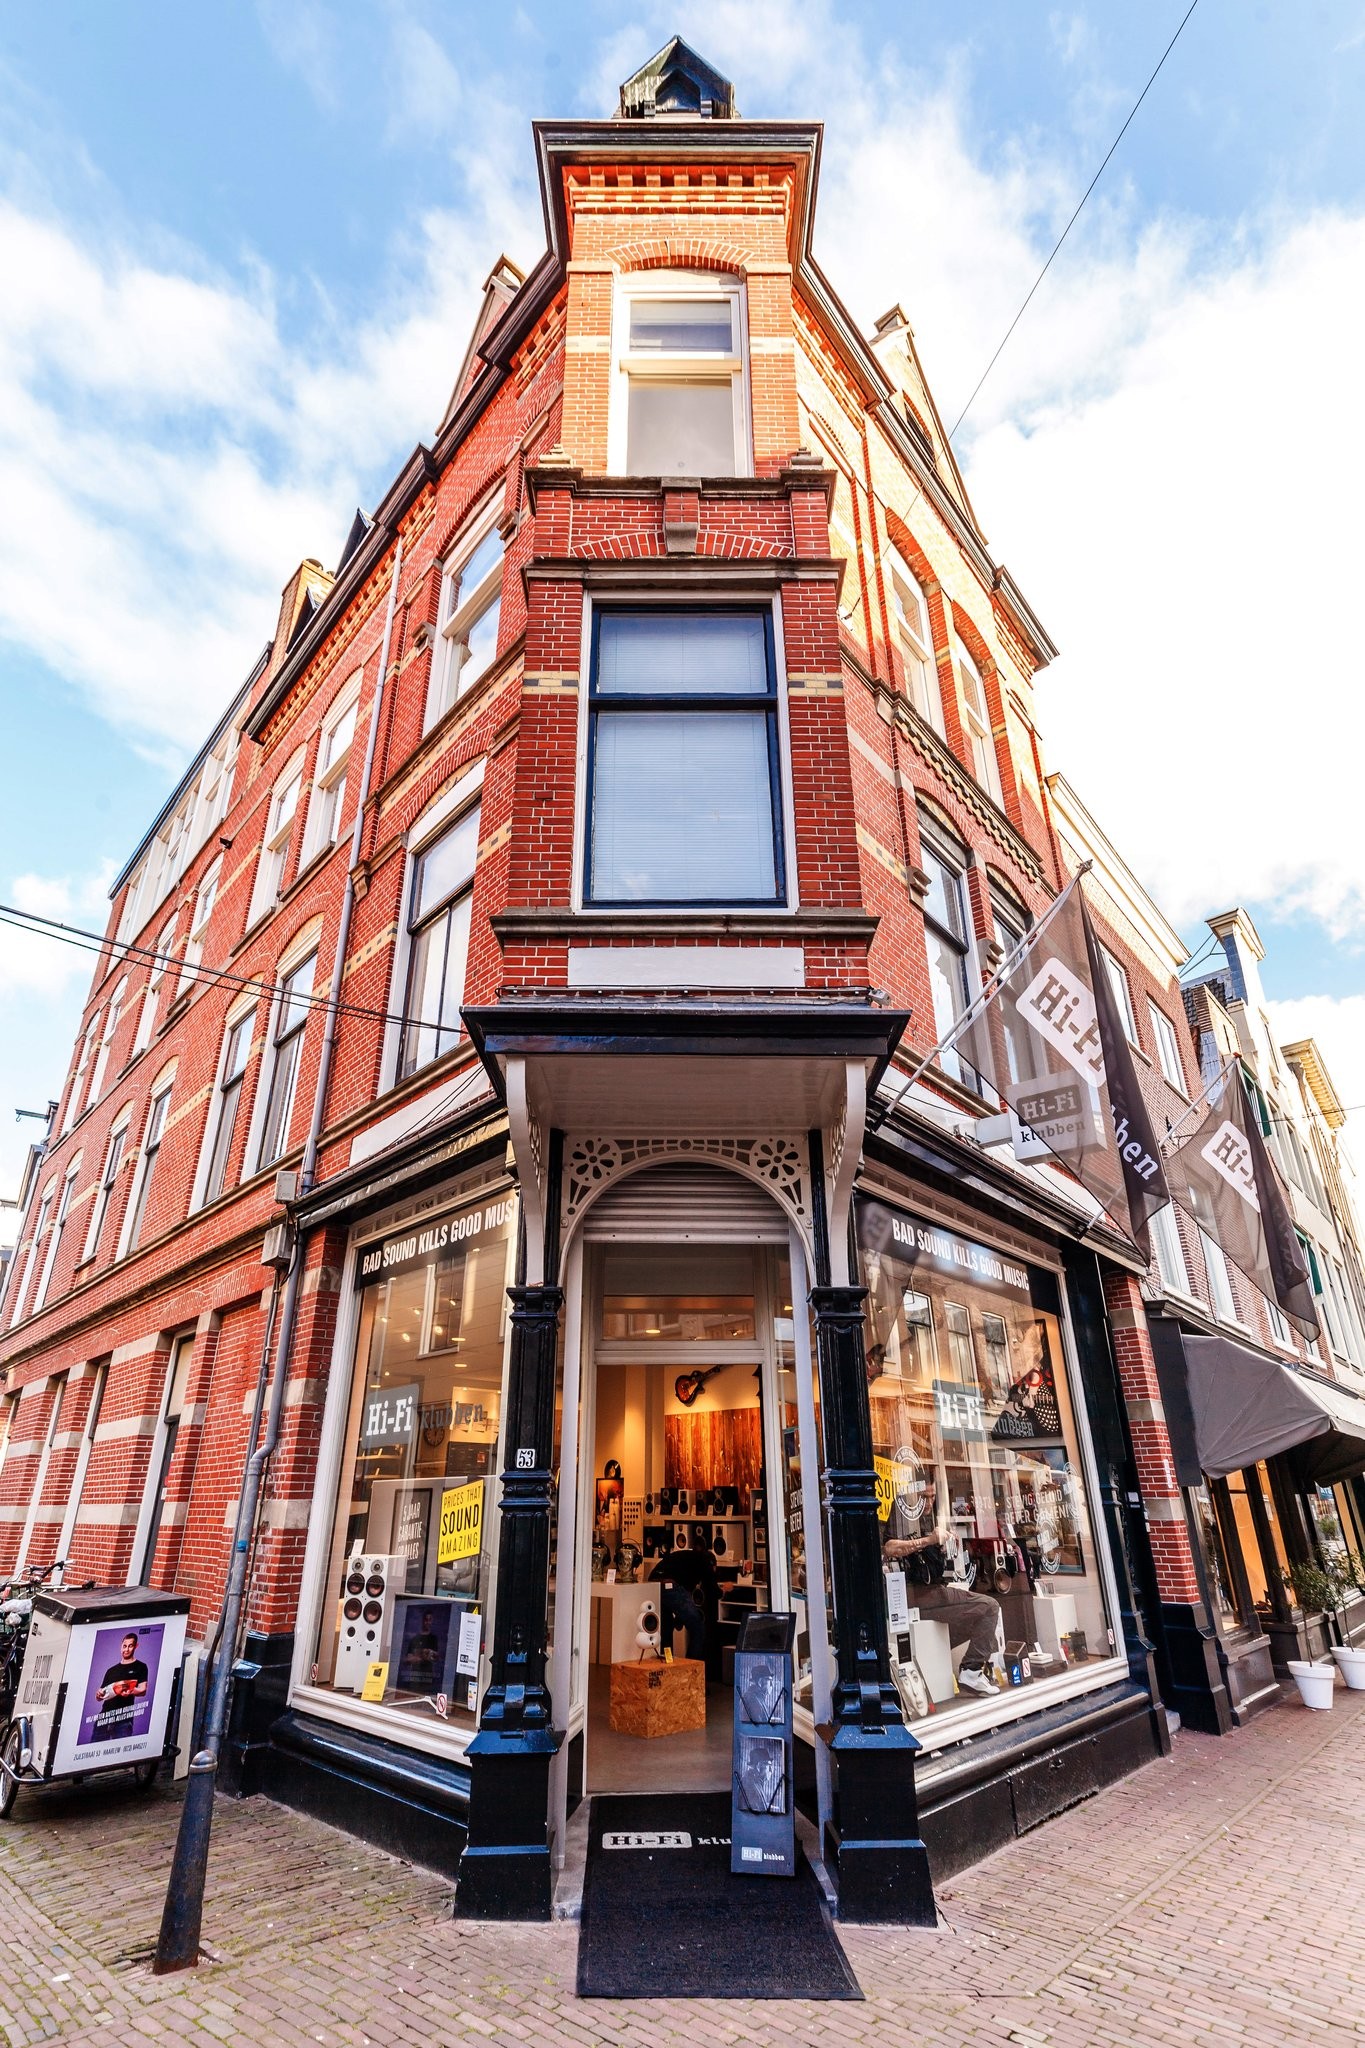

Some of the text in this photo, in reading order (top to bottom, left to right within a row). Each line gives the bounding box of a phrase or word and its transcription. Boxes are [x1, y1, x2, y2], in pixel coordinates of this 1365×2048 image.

[1021, 1091, 1078, 1120] Hi-Fi
[1021, 1120, 1085, 1143] klubben
[362, 1250, 381, 1275] BAD
[383, 1238, 416, 1268] SOUND
[418, 1224, 448, 1255] KILLS
[450, 1211, 482, 1242] GOOD
[892, 1218, 1030, 1291] BAD SOUND KILLS GOOD MUSIC
[366, 1395, 484, 1436] Hi-Fi klubben
[937, 1392, 984, 1431] Hi-Fi
[518, 1450, 534, 1467] 53
[443, 1485, 481, 1509] PRICES THAT
[1006, 1494, 1033, 1510] STEVIG
[397, 1521, 423, 1542] GARANTIE
[442, 1503, 480, 1536] SOUND
[440, 1532, 478, 1556] AMAZING
[610, 1835, 684, 1846] Hi-Fi
[763, 1852, 785, 1861] klubben
